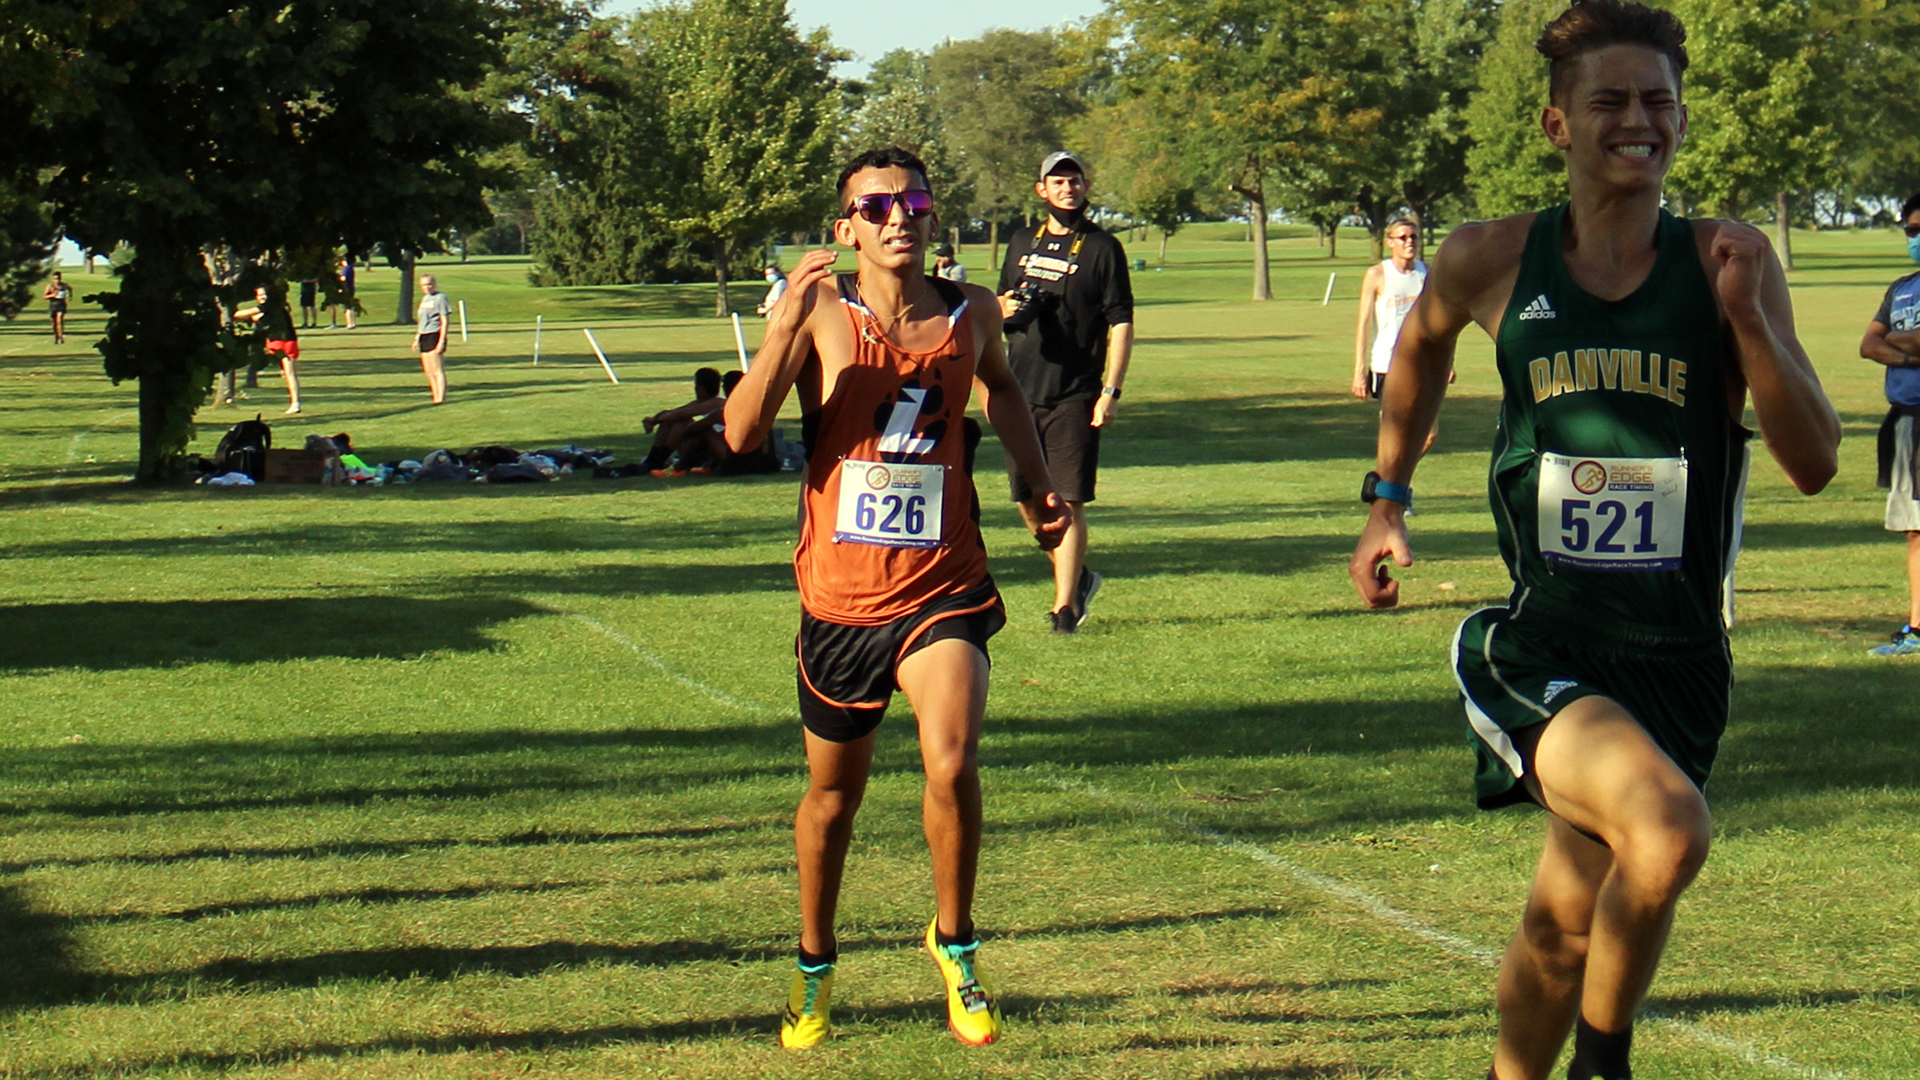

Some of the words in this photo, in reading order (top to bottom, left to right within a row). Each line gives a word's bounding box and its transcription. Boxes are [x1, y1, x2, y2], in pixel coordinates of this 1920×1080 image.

[1519, 309, 1556, 321] adidas
[1529, 348, 1687, 407] DANVILLE
[893, 475, 922, 483] EDGE
[1610, 472, 1653, 482] EDGE
[855, 492, 926, 535] 626
[1561, 498, 1658, 553] 521
[1543, 681, 1578, 704] adidas
